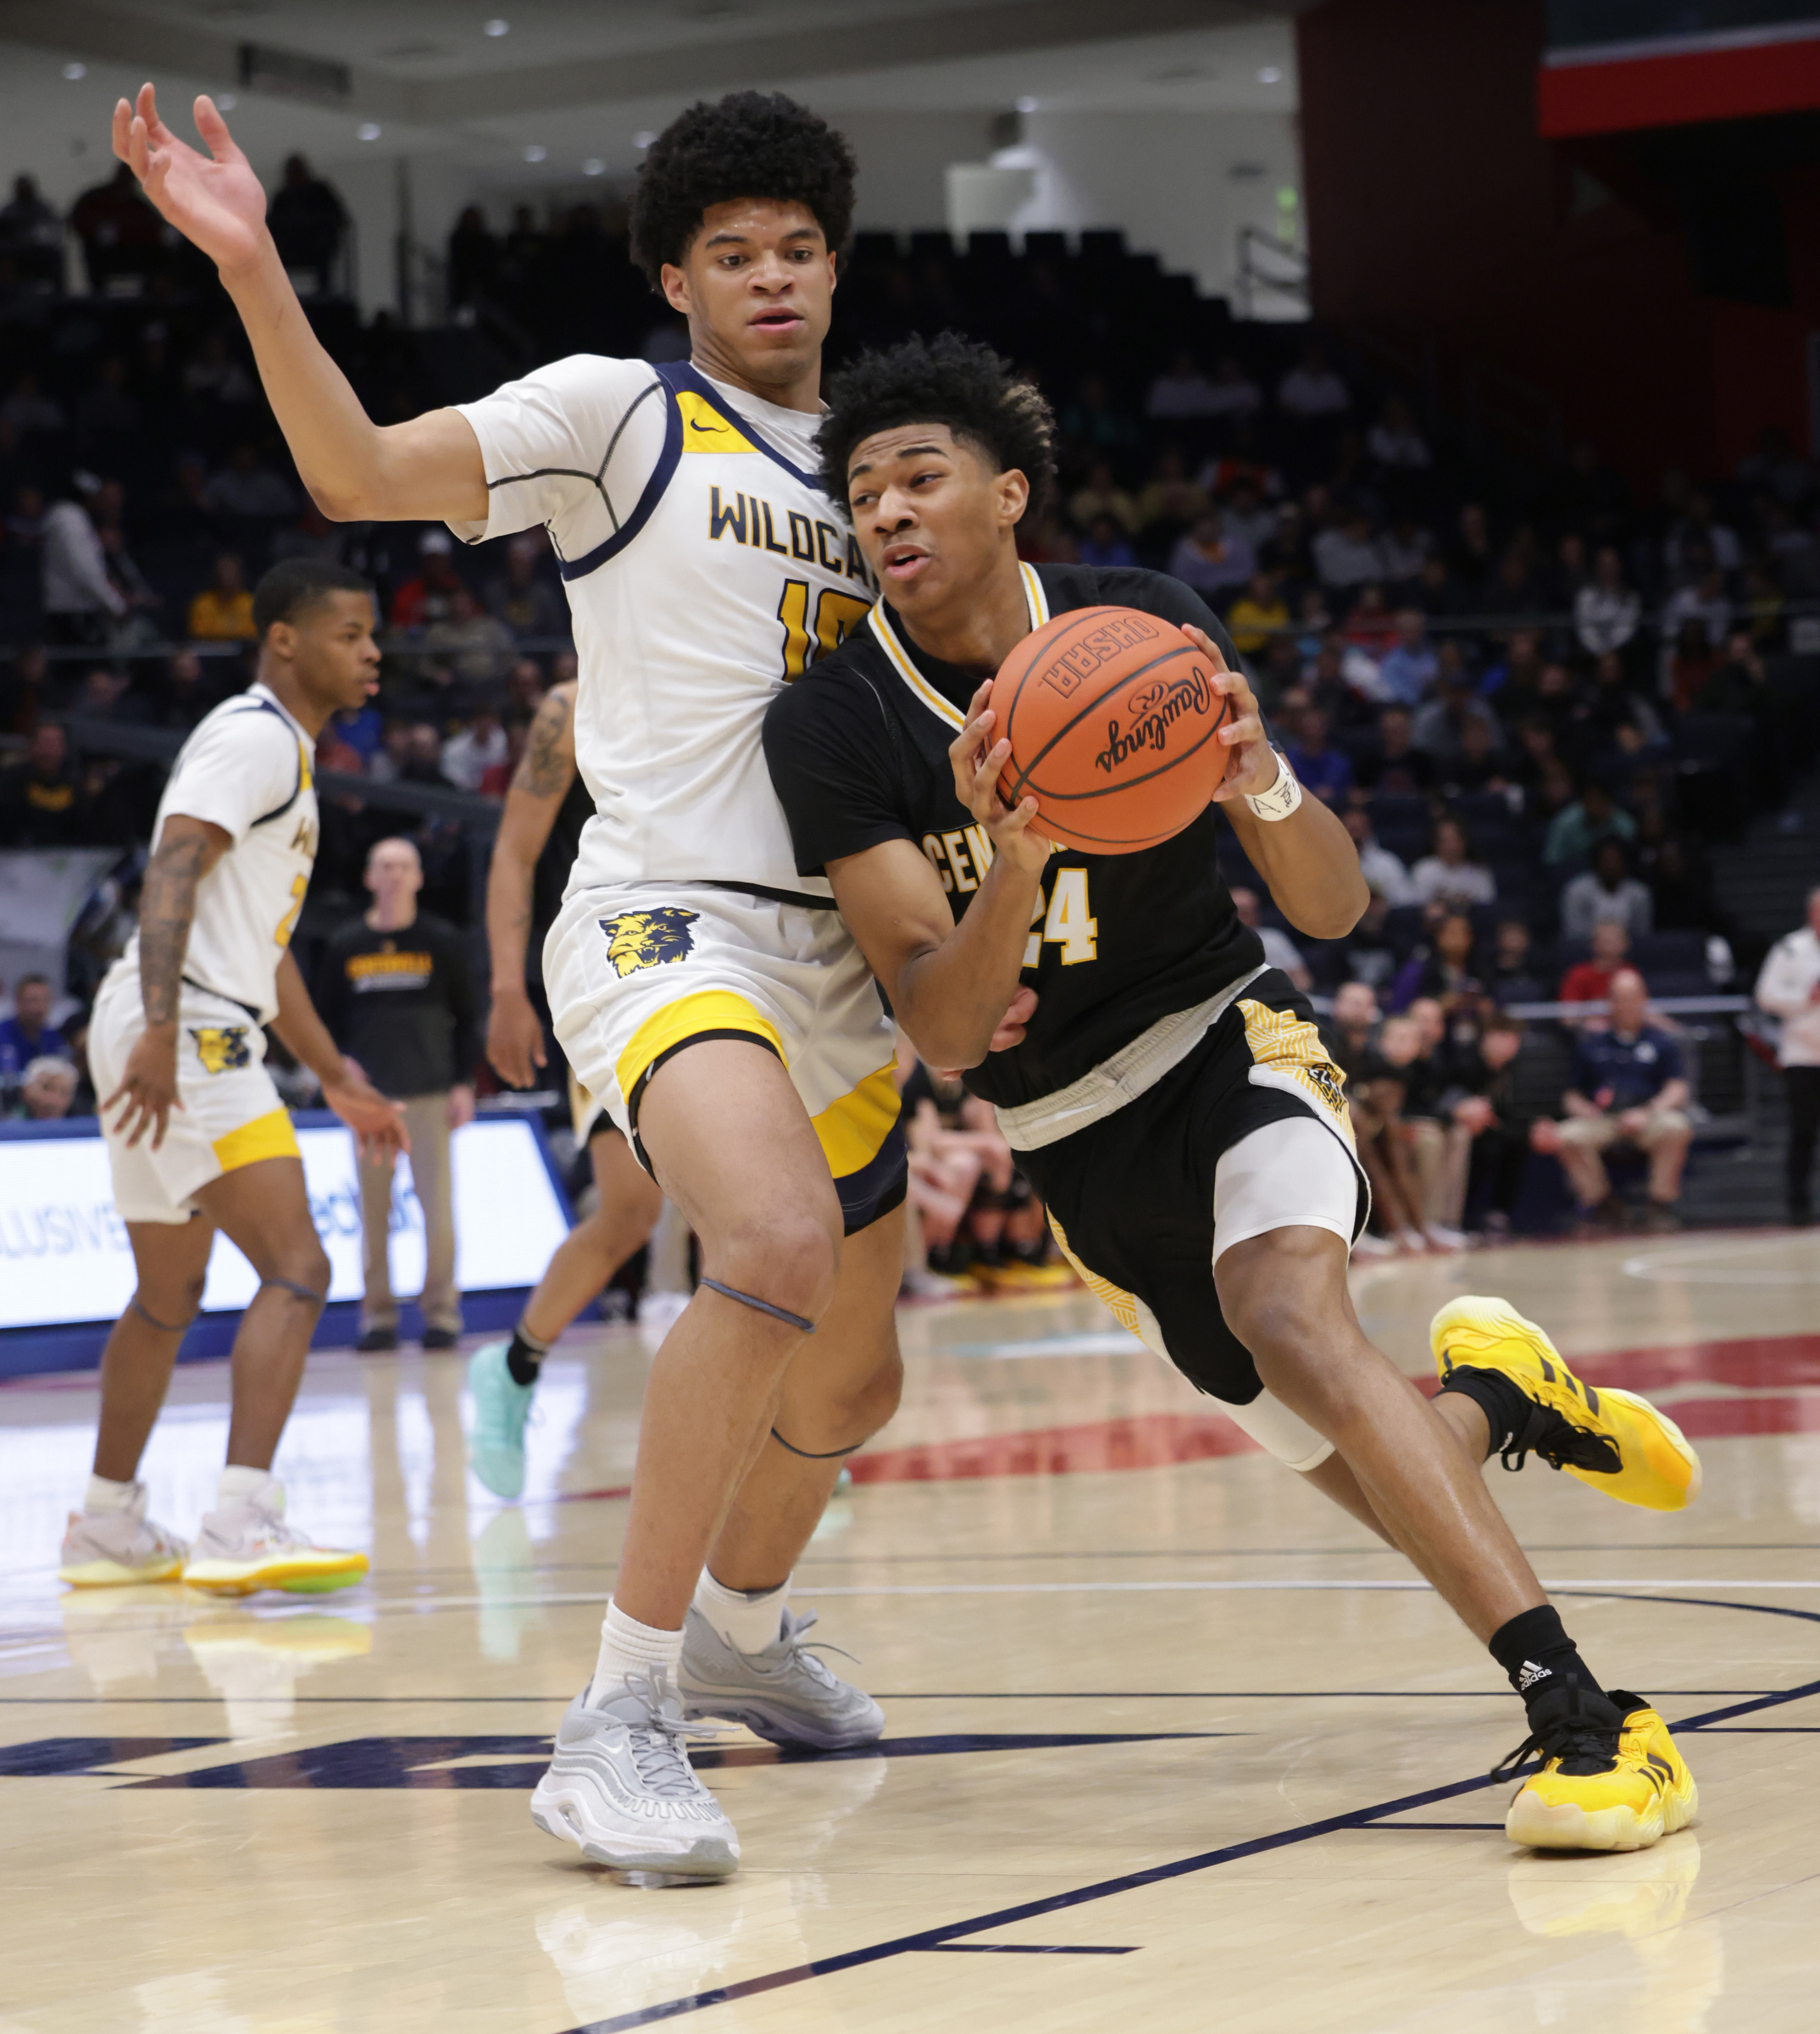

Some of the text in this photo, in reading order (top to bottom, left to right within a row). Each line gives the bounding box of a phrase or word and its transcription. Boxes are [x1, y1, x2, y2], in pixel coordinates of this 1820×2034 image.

[708, 485, 879, 593] WILDCA
[1042, 616, 1160, 698] OHSAA
[1095, 666, 1211, 773] Rawlings
[0, 1202, 130, 1259] LUSIVE
[1521, 1669, 1552, 1691] adidas
